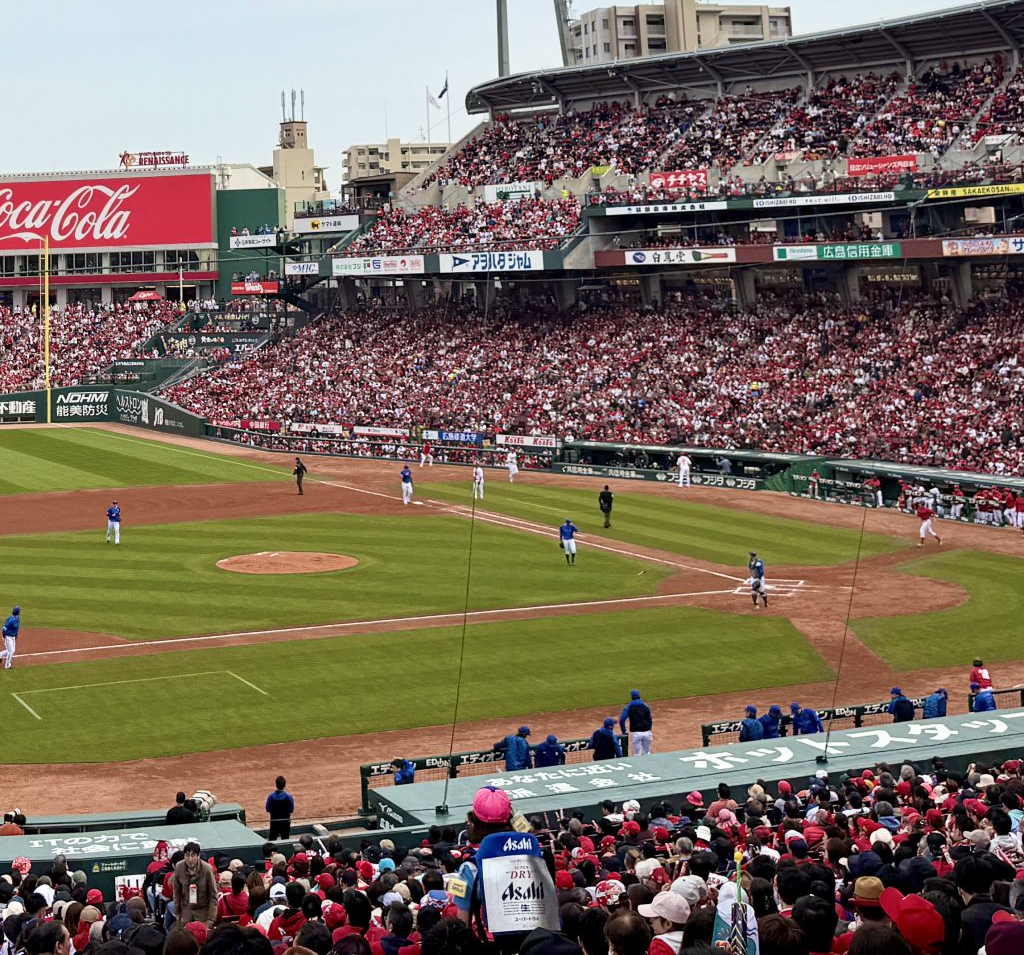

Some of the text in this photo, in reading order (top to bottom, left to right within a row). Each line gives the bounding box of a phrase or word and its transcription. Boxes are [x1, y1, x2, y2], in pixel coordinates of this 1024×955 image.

[138, 155, 189, 166] RENAISSANCE
[667, 173, 706, 187] チチヤス
[823, 244, 894, 258] 広島信用金庫
[472, 252, 532, 271] アヲハタ ジャム
[56, 391, 109, 404] NOHMI
[56, 405, 109, 417] 能美防災
[703, 475, 724, 486] フジタ
[736, 478, 756, 489] フジタ
[835, 708, 857, 717] EDION
[679, 712, 1024, 770] ホットスタッ
[460, 751, 504, 765] エディオン
[485, 762, 633, 786] あなたに近い
[29, 832, 149, 848] ITの力で
[503, 837, 533, 852] Asahi
[510, 870, 532, 880] DRY
[501, 881, 545, 902] Asahi
